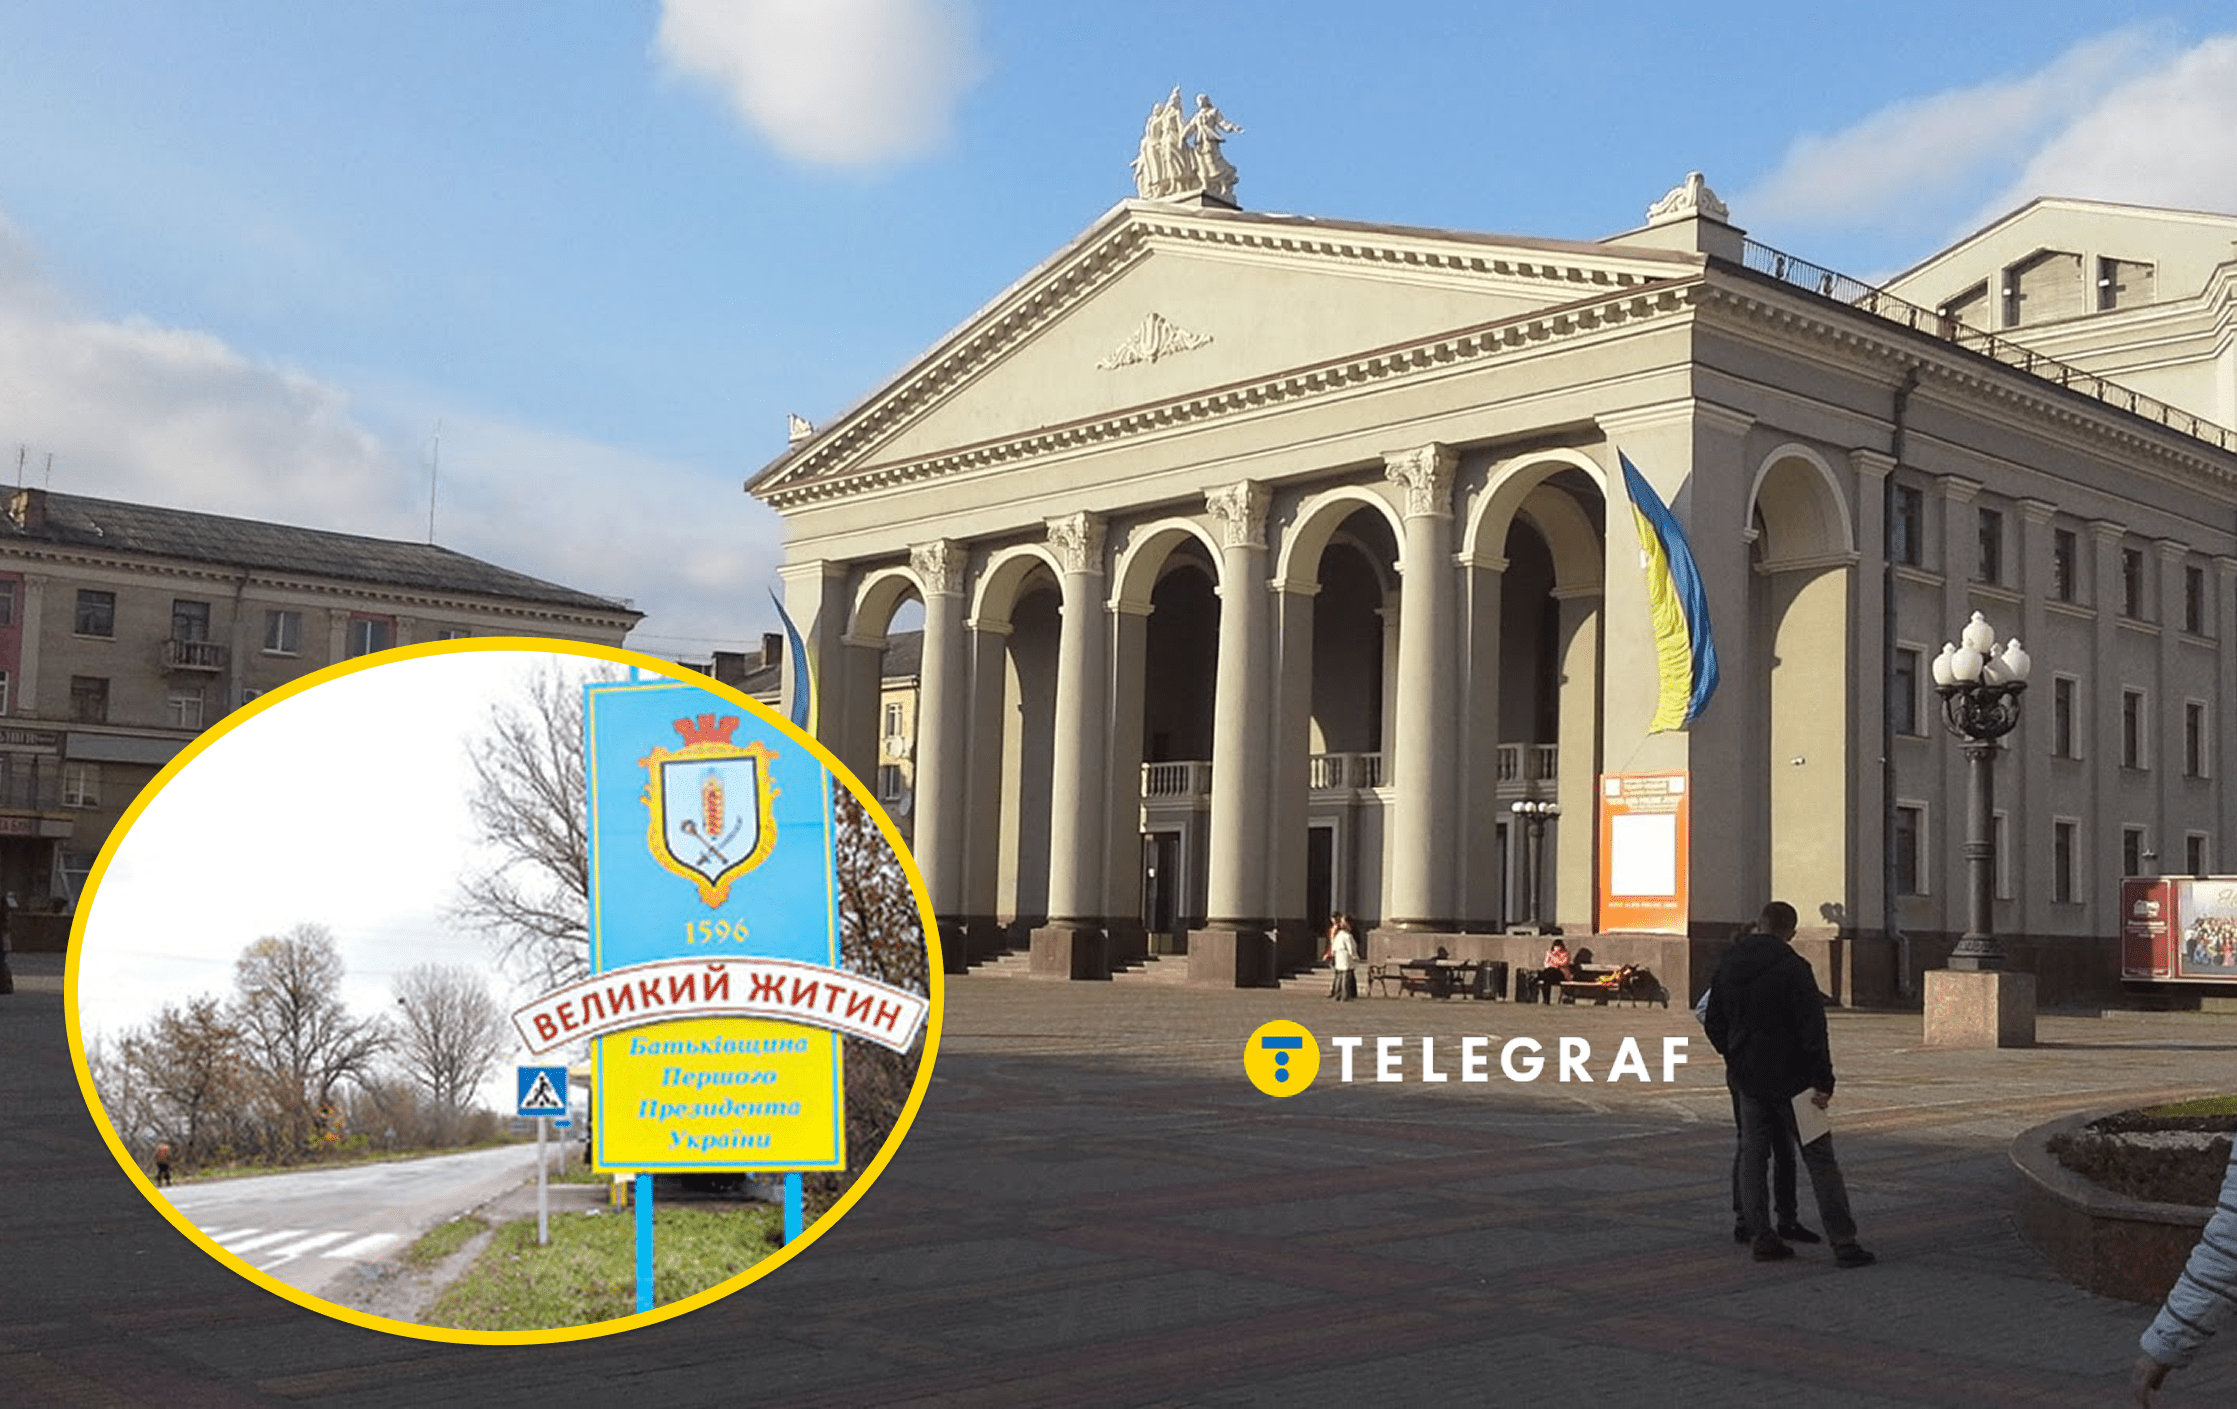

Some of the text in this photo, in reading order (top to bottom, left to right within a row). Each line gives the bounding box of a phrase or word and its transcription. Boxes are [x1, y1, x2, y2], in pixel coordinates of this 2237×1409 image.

[685, 918, 749, 944] 1596
[533, 964, 902, 1042] ВЕЛИКИЙ ЖИТИН
[629, 1035, 809, 1056] Батьківщина
[661, 1067, 778, 1090] Першого
[637, 1096, 802, 1122] Президента
[668, 1128, 772, 1154] України
